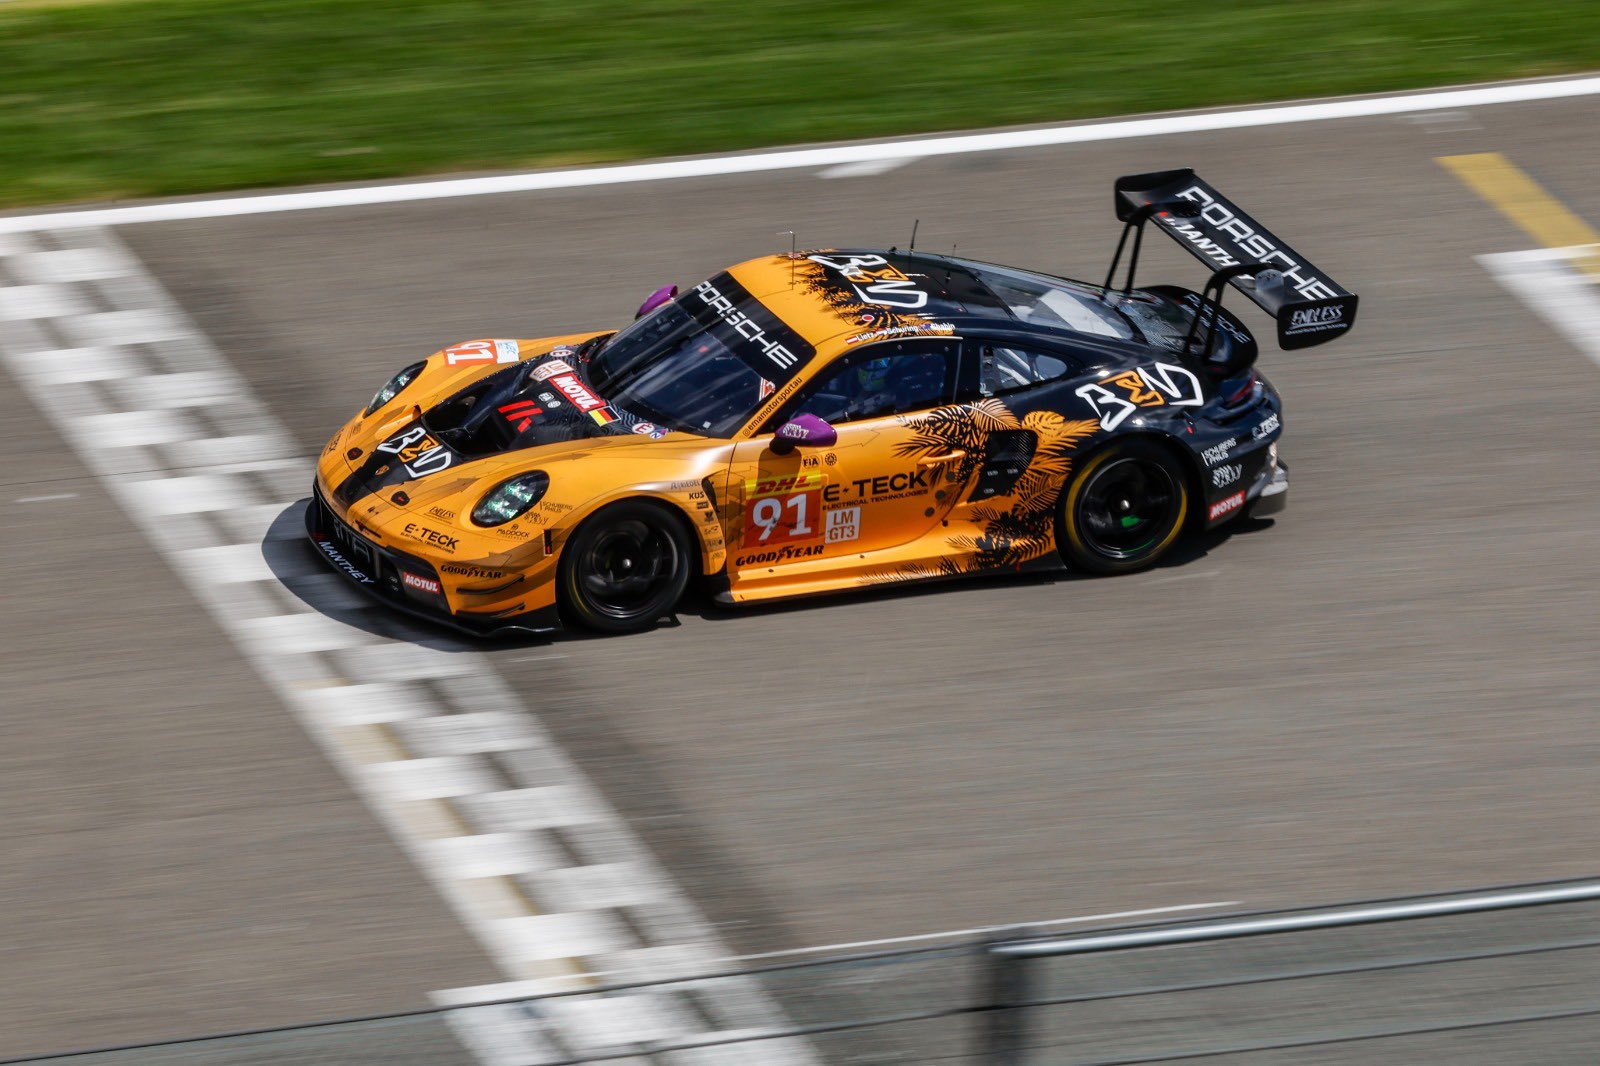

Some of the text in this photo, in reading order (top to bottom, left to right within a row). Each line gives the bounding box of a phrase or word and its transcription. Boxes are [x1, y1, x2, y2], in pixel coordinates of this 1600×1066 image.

[693, 280, 799, 370] PORSCHE
[553, 375, 600, 409] MOTUL
[803, 458, 819, 467] FIA
[689, 491, 705, 500] KUS
[756, 476, 812, 495] DHL
[1211, 494, 1243, 518] MOTUL
[753, 493, 812, 541] 91
[833, 510, 854, 526] LM
[829, 525, 855, 541] GT3
[319, 541, 375, 583] MANTHEY
[735, 544, 825, 567] GOODYEAR
[405, 575, 438, 592] MOTUL
